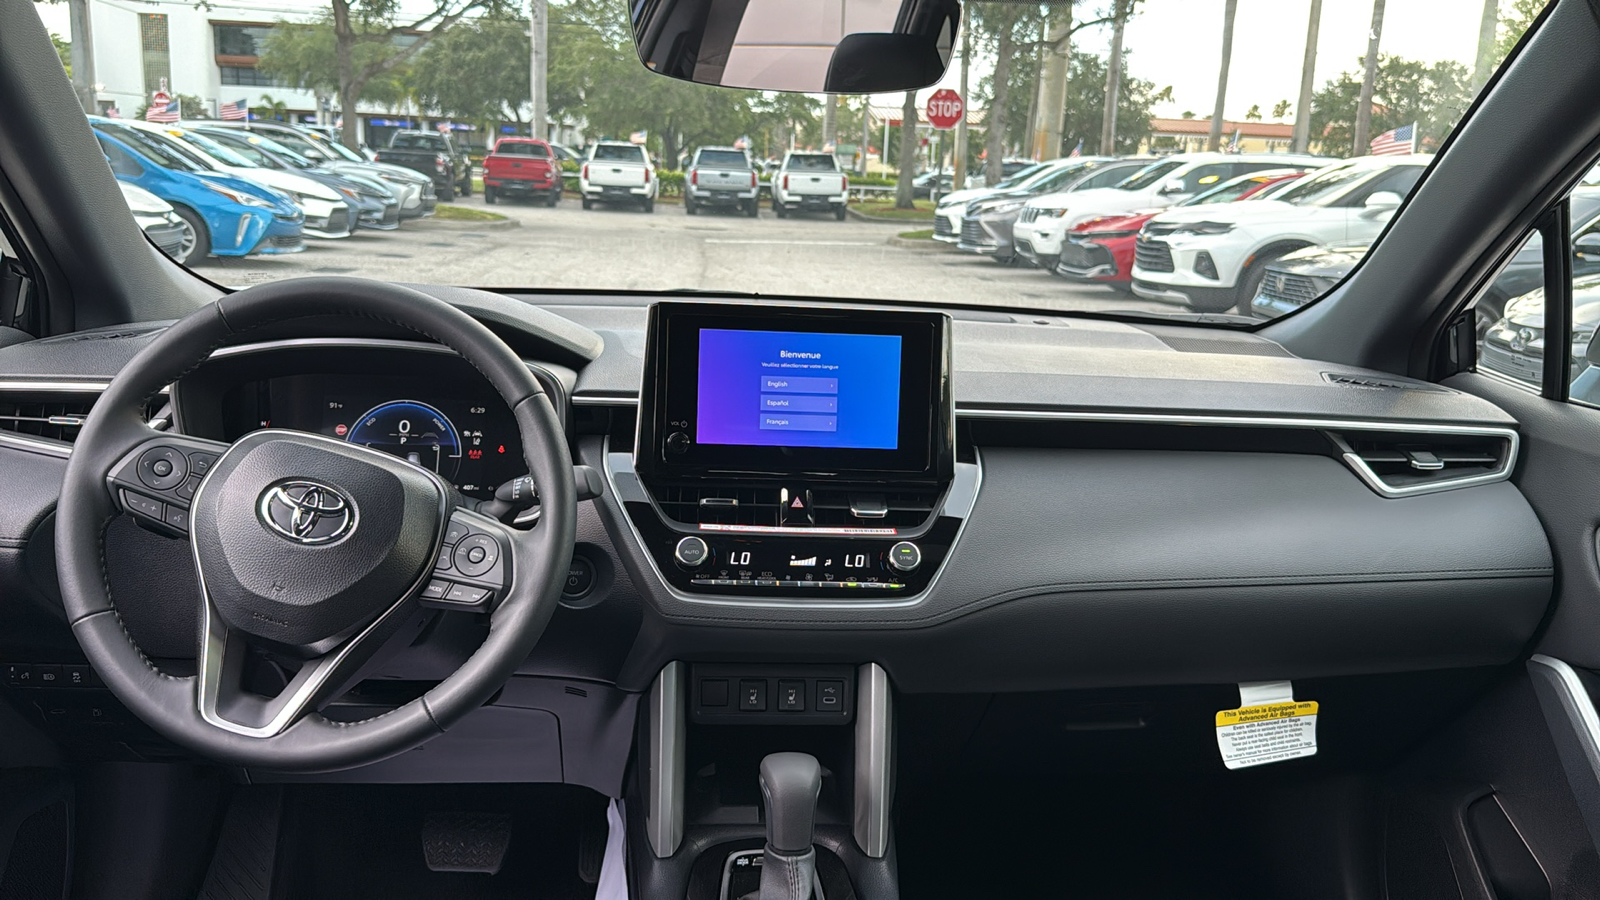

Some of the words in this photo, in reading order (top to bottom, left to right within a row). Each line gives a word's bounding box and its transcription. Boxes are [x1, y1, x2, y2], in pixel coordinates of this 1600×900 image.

[928, 100, 961, 118] STOP
[780, 350, 821, 360] Bienvenue
[366, 418, 376, 426] ECO
[399, 420, 410, 433] 0
[432, 418, 446, 431] POWER
[730, 552, 750, 565] LO
[844, 554, 865, 568] LO
[1268, 704, 1296, 713] Equipped
[1239, 713, 1268, 722] Advanced
[1280, 710, 1295, 718] Bags
